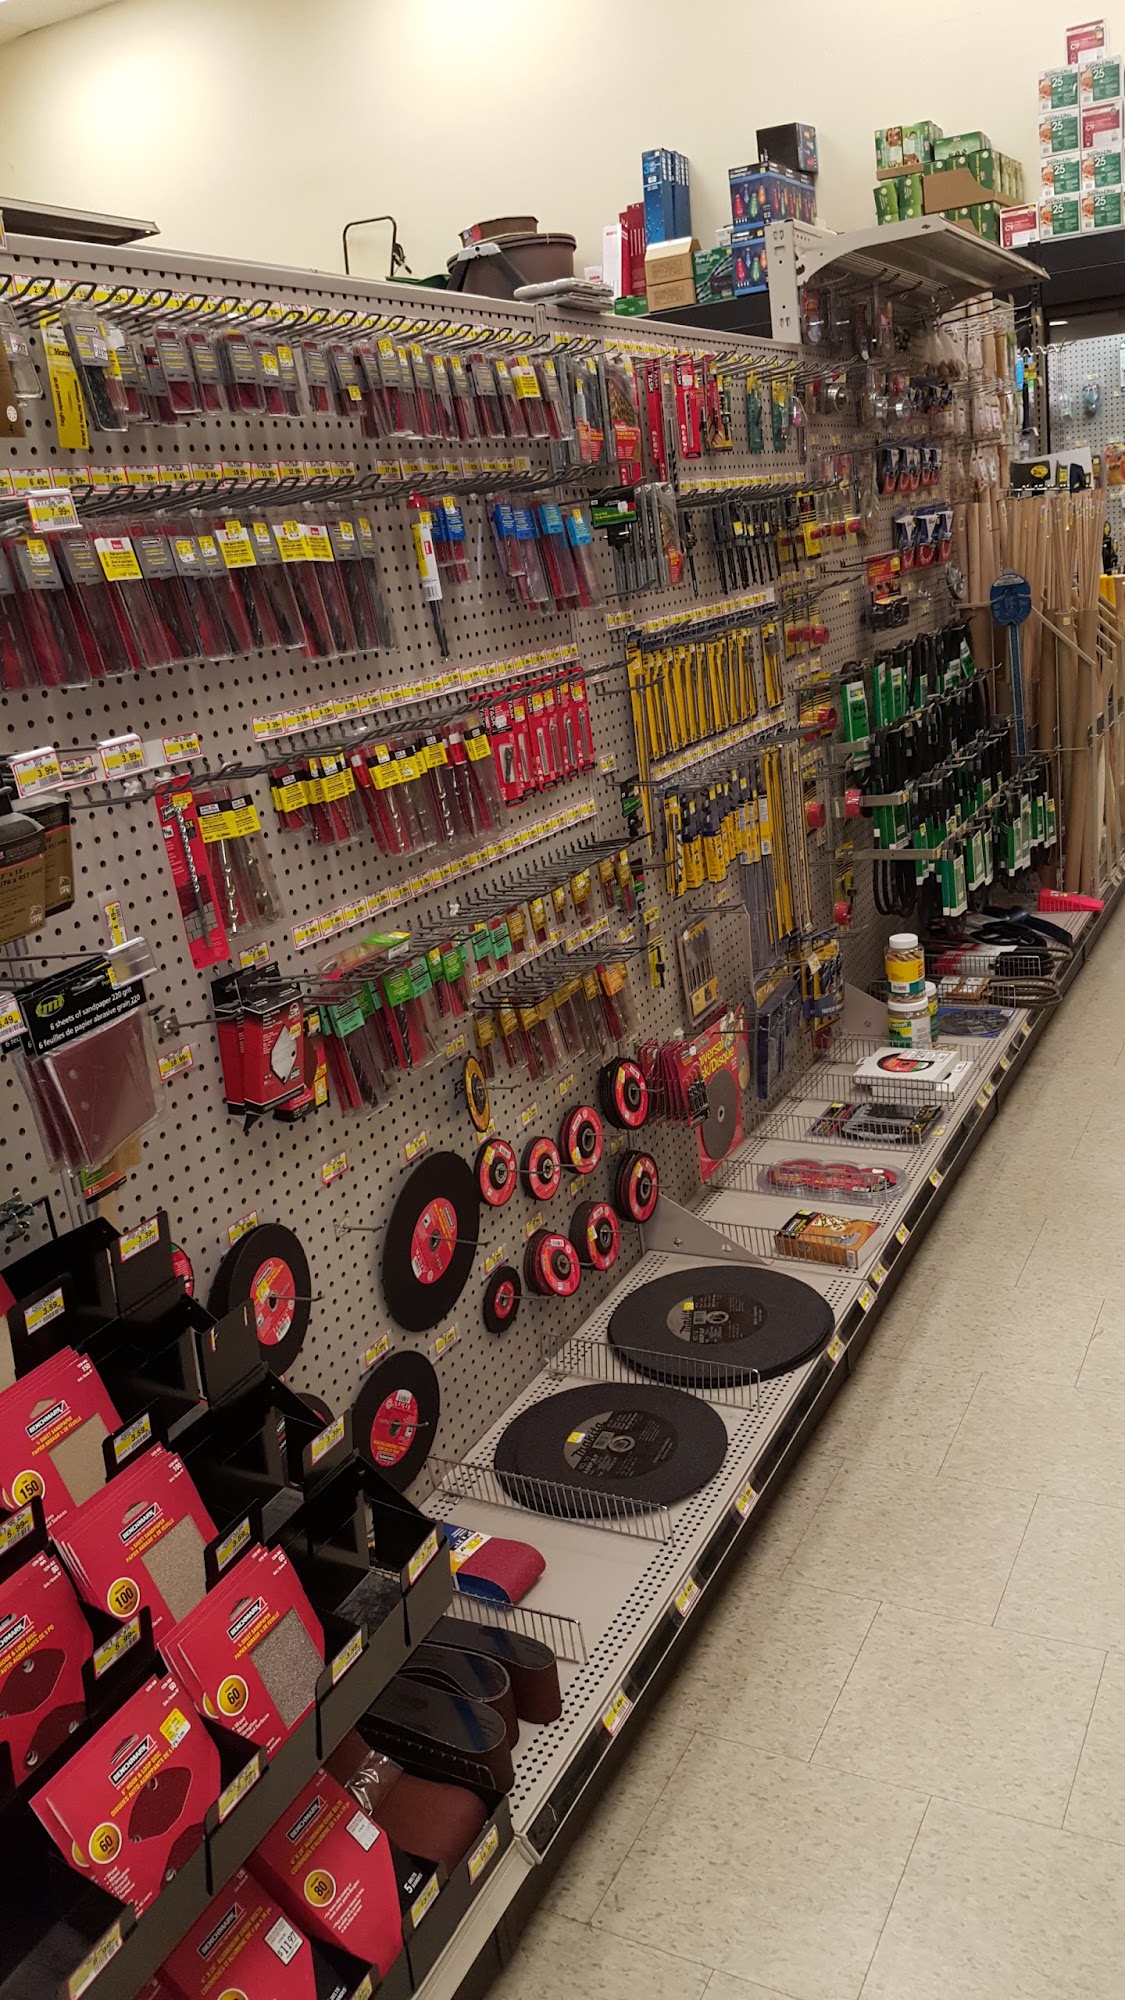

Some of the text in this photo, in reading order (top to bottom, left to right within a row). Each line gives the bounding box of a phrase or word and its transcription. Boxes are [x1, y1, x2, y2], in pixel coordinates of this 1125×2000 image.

[1052, 77, 1063, 87] 25
[1093, 69, 1105, 79] 25
[1052, 121, 1063, 131] 25
[643, 162, 650, 174] 3
[1054, 165, 1065, 175] 25
[1095, 157, 1106, 167] 25
[1053, 204, 1064, 214] 25
[1095, 196, 1106, 206] 25
[50, 507, 67, 517] 7.99
[37, 766, 54, 778] 3.99
[30, 915, 42, 924] LIFE
[55, 1015, 75, 1029] sheets
[75, 1010, 82, 1019] of
[82, 997, 112, 1015] sandpaper
[111, 991, 122, 1001] 220
[122, 986, 132, 998] grit
[43, 1031, 65, 1047] feuilles
[65, 1026, 74, 1036] de
[74, 1018, 93, 1034] papier
[93, 1007, 116, 1023] abrasive
[116, 999, 131, 1013] grain
[130, 993, 141, 1005] 220
[699, 1036, 724, 1066] iversal
[701, 1046, 734, 1079] sk/Disque
[43, 1300, 57, 1315] 3.59
[29, 1406, 63, 1434] BENCHMARK
[40, 1416, 73, 1443] SHEET SANDPAPER
[32, 1444, 44, 1456] PAPIER
[44, 1433, 60, 1447] ABRASIF
[68, 1416, 82, 1430] FEUILLE
[131, 1427, 145, 1441] 3.59
[20, 1480, 39, 1499] 150
[122, 1509, 155, 1540] BENCHMARK
[134, 1518, 166, 1550] SHEET SANDPAPER
[125, 1550, 138, 1563] PAPIER
[138, 1537, 153, 1553] ABRASIF
[162, 1518, 175, 1532] FEUILLE
[115, 1587, 134, 1609] 100
[47, 1624, 55, 1633] PO
[230, 1605, 261, 1636] BENCHMARK
[241, 1613, 271, 1646] SHEET SANDPAPER
[0, 1622, 26, 1648] CHMARK
[15, 1640, 28, 1652] LOOP
[27, 1631, 38, 1642] DISC
[234, 1646, 247, 1660] PAPIER
[246, 1632, 261, 1650] ABRASIF
[268, 1611, 280, 1626] FEUILLE
[227, 1688, 240, 1705] 60
[112, 1743, 148, 1782] BENCHMARK
[126, 1775, 138, 1791] HOOK
[141, 1760, 153, 1775] LOOP
[151, 1751, 162, 1765] DISC
[110, 1796, 130, 1818] DISQUES
[128, 1757, 164, 1798] AUTO-AGRIPPANTS
[162, 1752, 170, 1762] DE
[290, 1804, 321, 1839] BENCHMARK
[102, 1834, 113, 1852] 60
[314, 1880, 328, 1897] 80
[403, 1883, 412, 1894] 5
[201, 1915, 236, 1955] BENCHMARK
